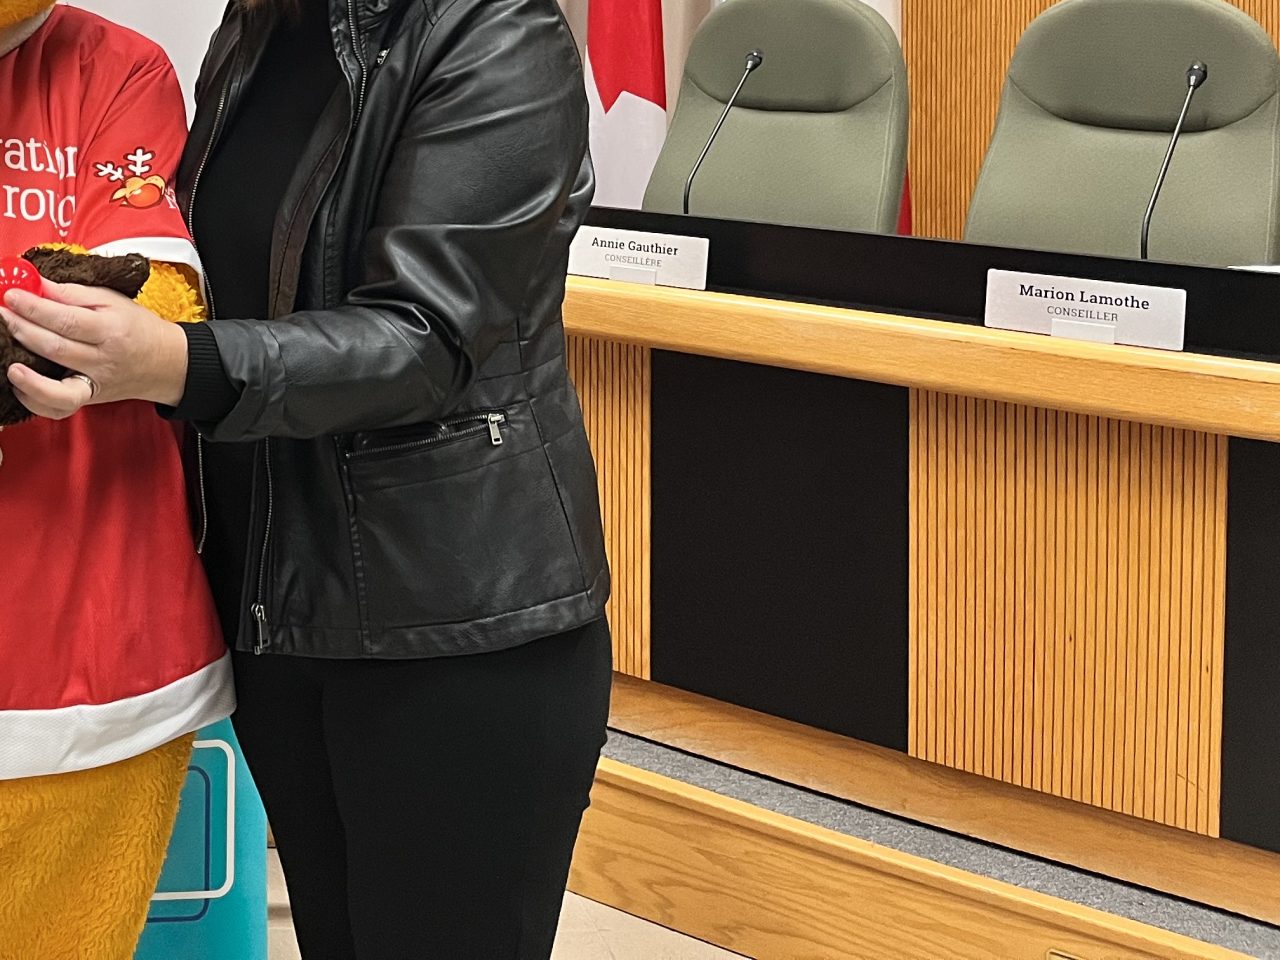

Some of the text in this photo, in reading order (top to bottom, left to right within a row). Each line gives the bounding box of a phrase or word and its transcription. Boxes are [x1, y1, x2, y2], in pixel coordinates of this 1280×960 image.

[591, 237, 679, 257] Annie Gauthier
[604, 253, 663, 268] CONSEILLÈRE
[1019, 284, 1150, 310] Marion Lamothe
[1047, 305, 1118, 322] CONSEILLER
